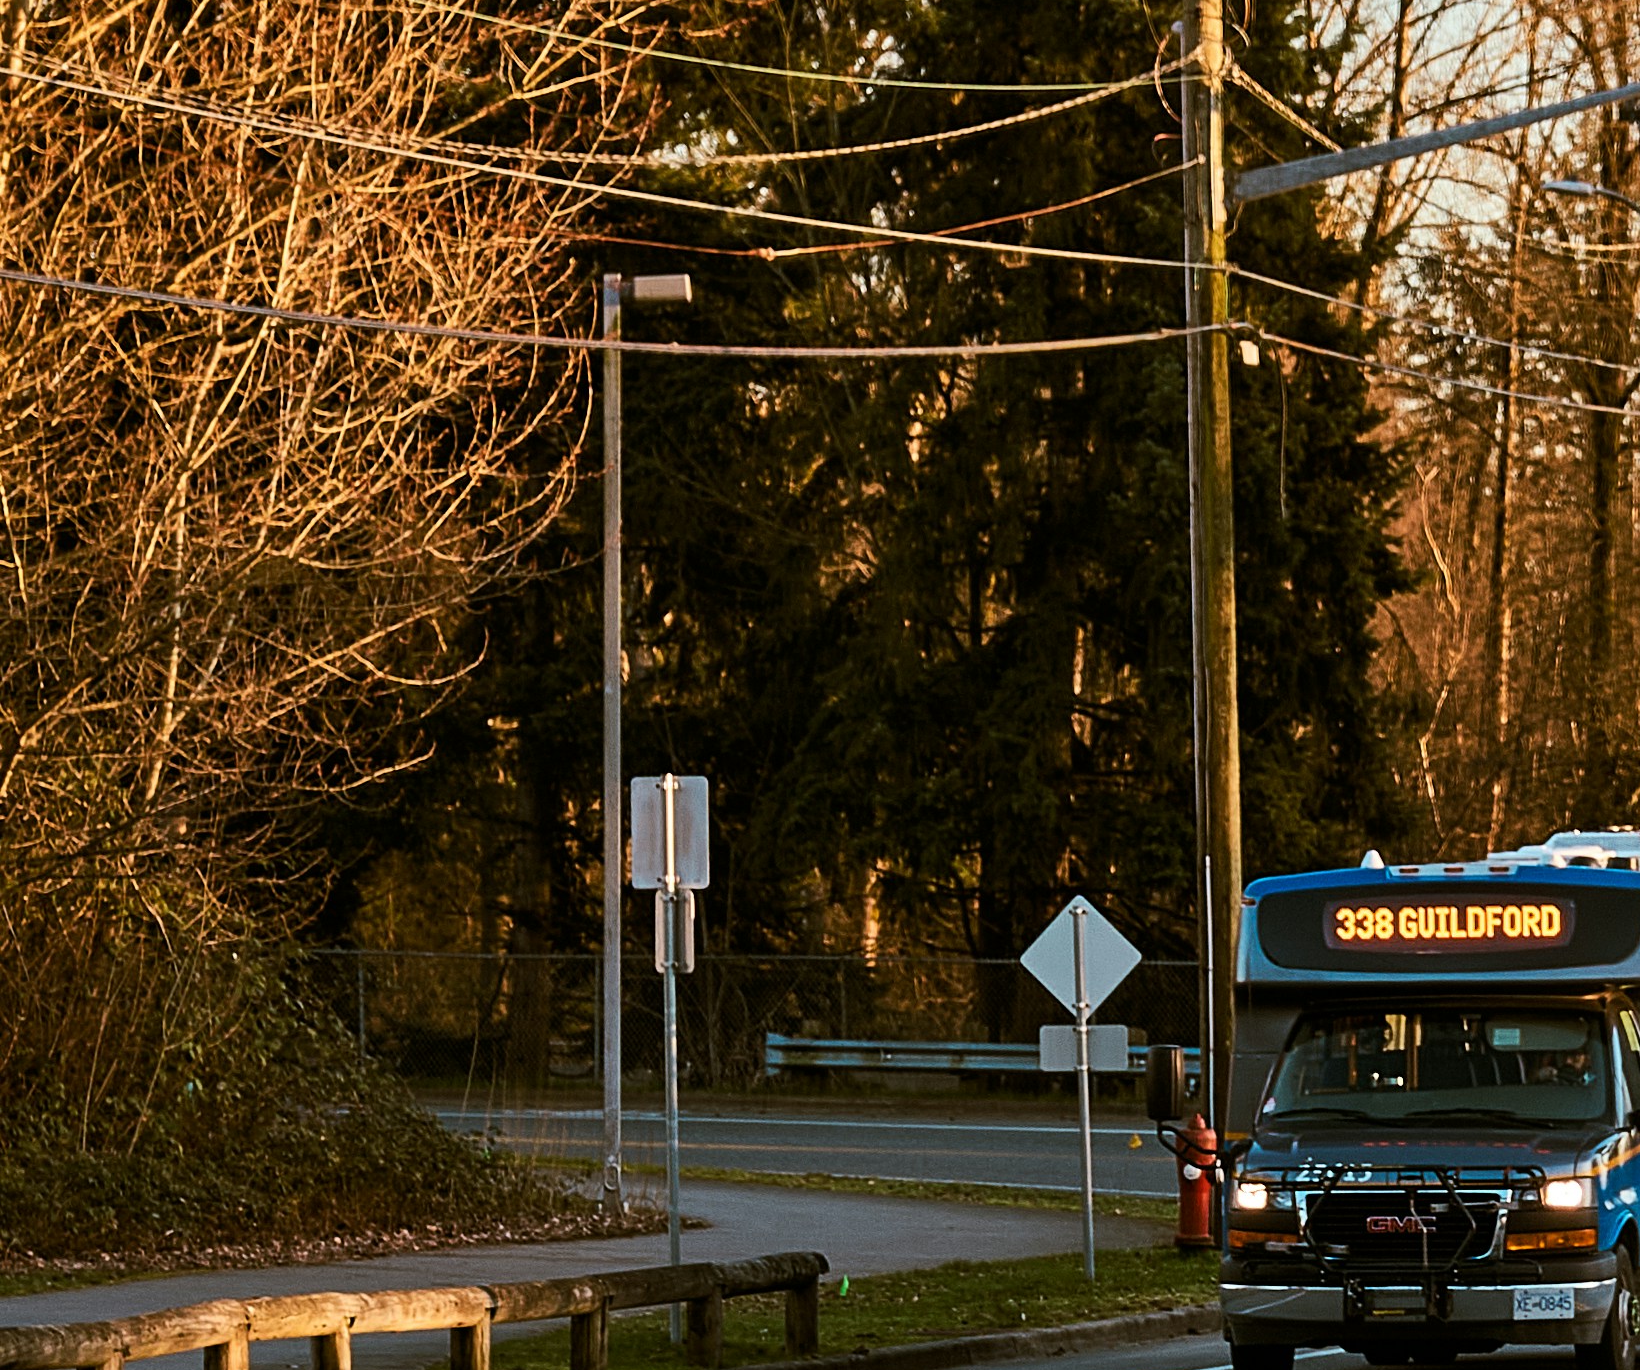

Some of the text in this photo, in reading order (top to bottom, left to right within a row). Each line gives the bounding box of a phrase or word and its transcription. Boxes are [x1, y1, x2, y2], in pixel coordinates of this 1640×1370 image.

[1336, 904, 1561, 940] 338 GUILDFORD
[1367, 1216, 1436, 1233] GMC
